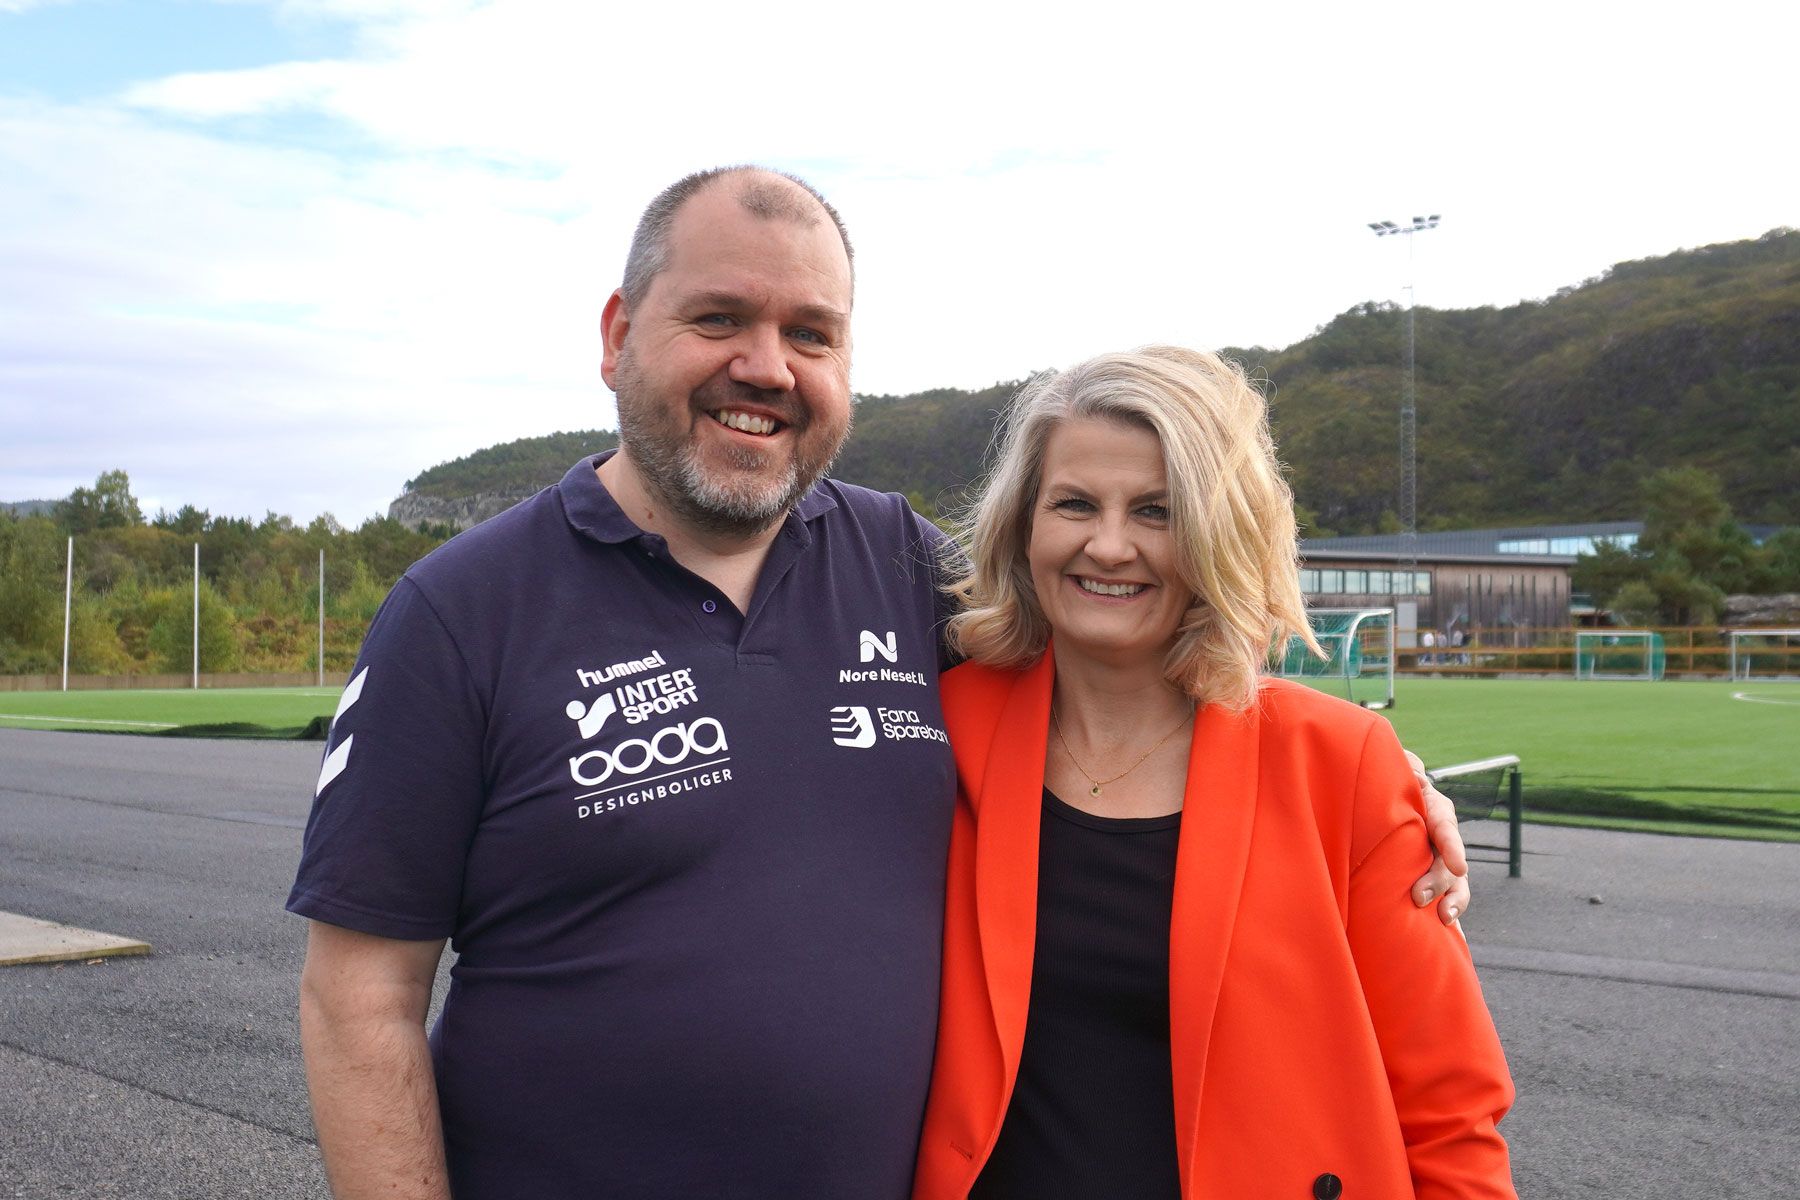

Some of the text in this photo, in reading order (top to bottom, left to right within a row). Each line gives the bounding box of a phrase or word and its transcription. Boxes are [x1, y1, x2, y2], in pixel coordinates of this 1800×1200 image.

[576, 650, 667, 688] hummel
[839, 668, 927, 687] Nore Neset IL
[615, 669, 694, 708] INTER
[622, 685, 699, 725] SPORT
[876, 707, 921, 724] Fana
[882, 722, 950, 746] Spareban
[577, 768, 733, 819] DESIGNBOLIGER
